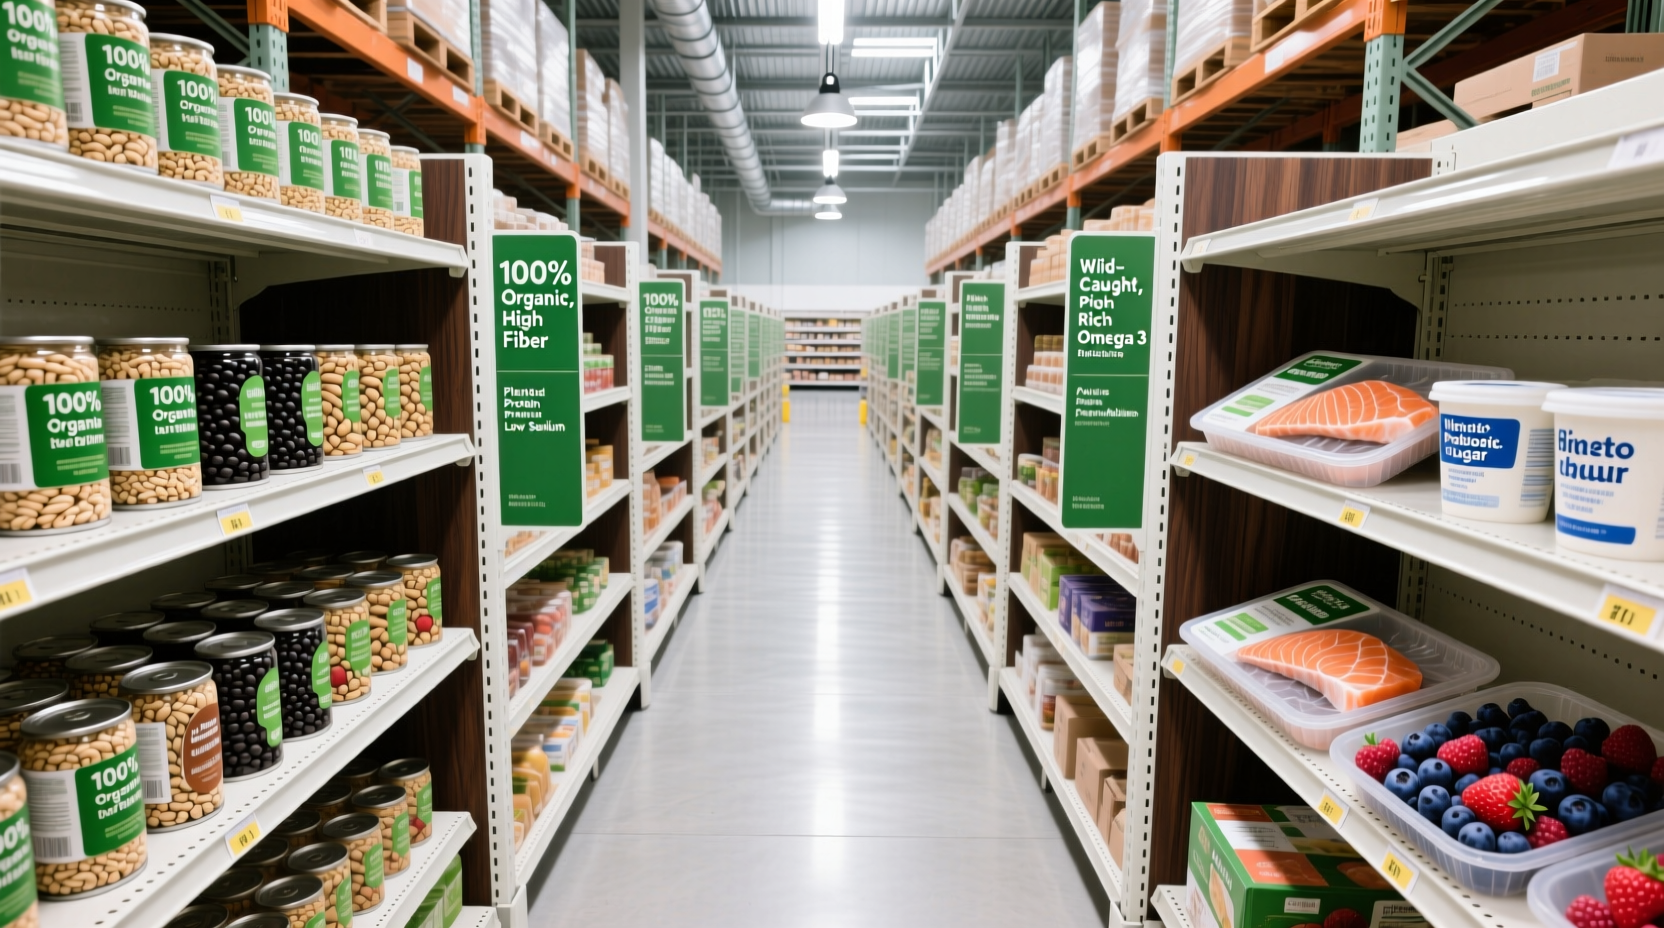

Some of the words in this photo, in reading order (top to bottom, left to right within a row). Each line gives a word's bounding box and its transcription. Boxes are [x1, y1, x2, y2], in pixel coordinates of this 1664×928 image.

[499, 259, 572, 285] 100%
[1079, 275, 1143, 297] Caught,
[501, 288, 574, 311] Organic,
[502, 309, 543, 331] High
[1078, 311, 1112, 327] Rich
[503, 330, 549, 349] Fiber
[1077, 329, 1134, 349] Omega
[1137, 329, 1147, 345] 3
[42, 389, 102, 416] 100%
